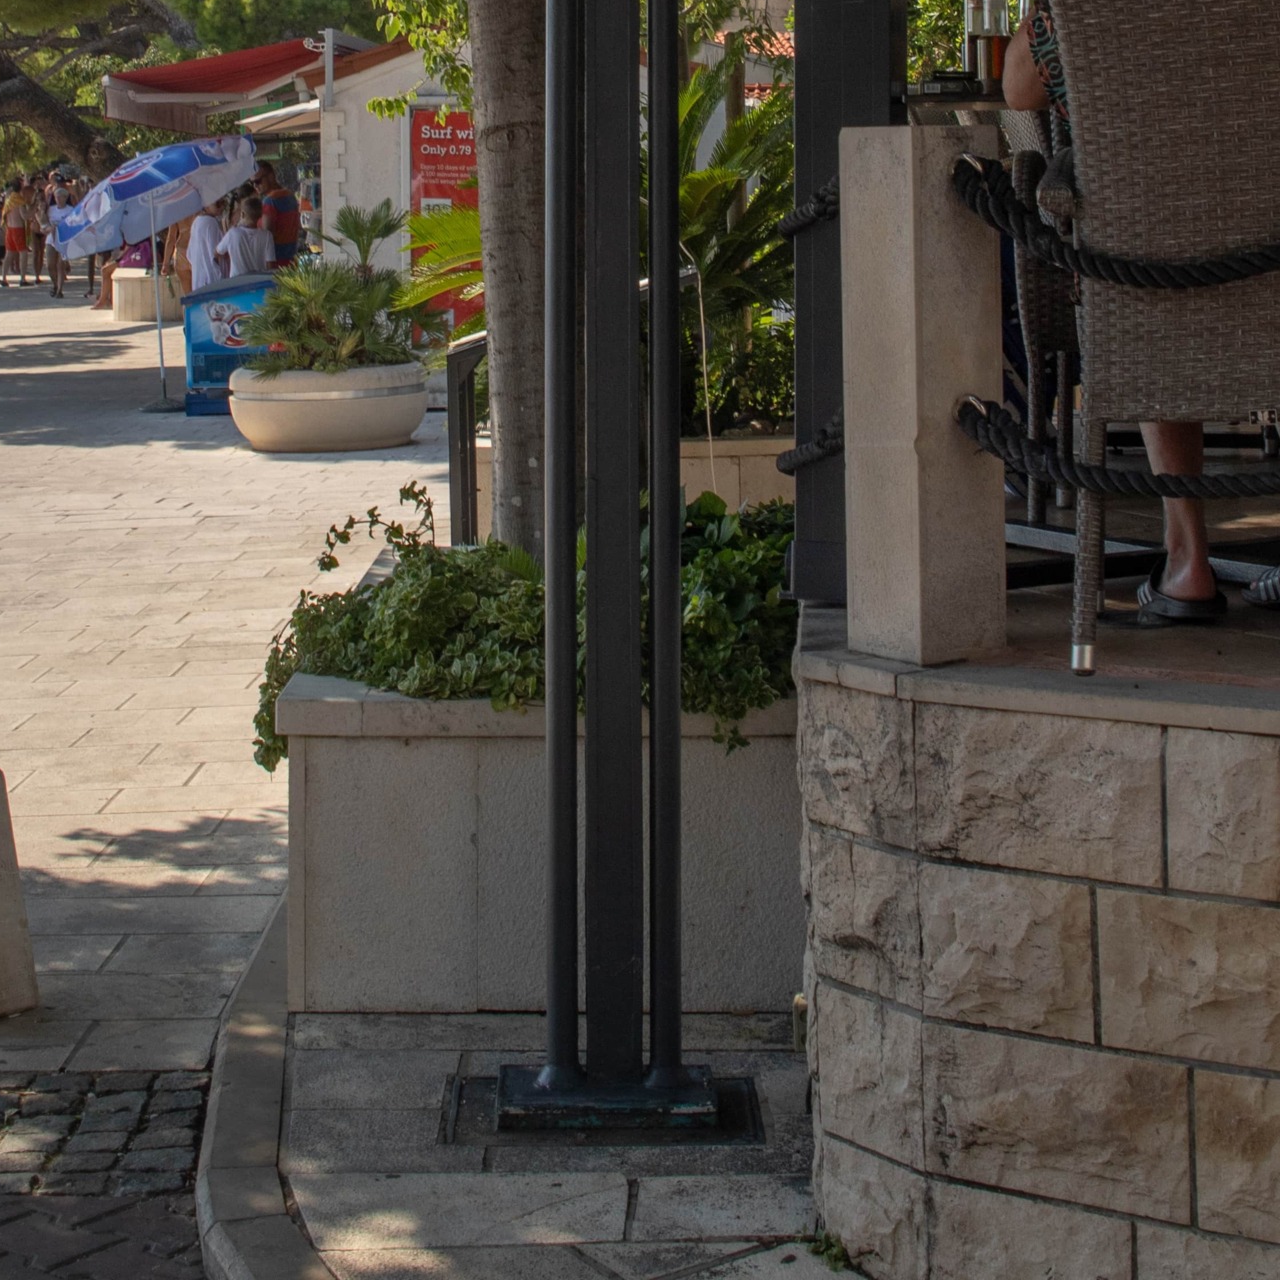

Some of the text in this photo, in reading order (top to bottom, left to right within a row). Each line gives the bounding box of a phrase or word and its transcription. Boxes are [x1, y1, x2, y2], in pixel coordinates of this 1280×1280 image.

[421, 125, 453, 139] Surf
[421, 144, 472, 157] Only 0.79
